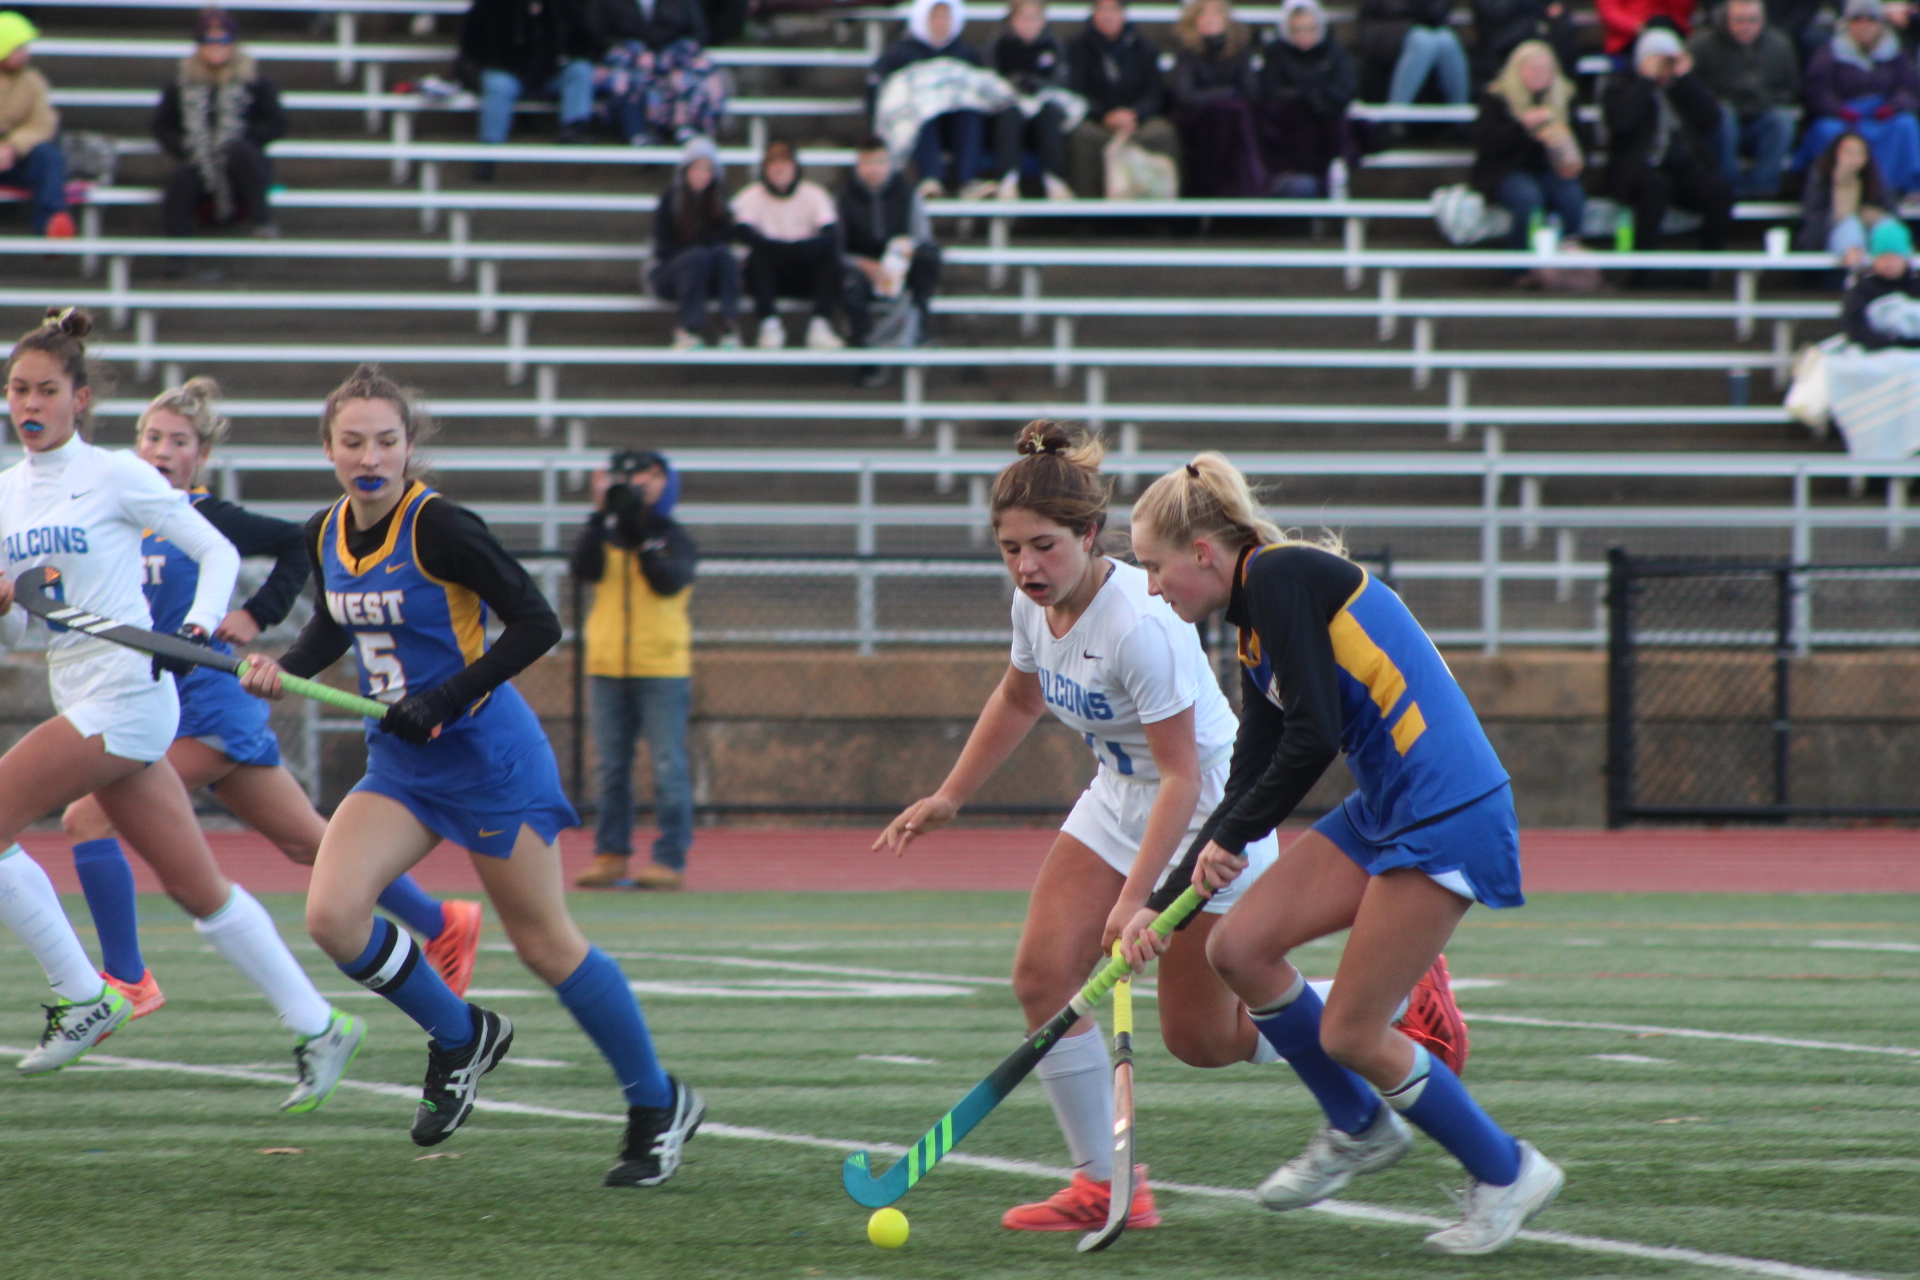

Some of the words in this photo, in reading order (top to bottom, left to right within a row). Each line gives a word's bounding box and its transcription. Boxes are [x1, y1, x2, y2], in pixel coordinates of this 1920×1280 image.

[325, 589, 405, 625] WEST
[354, 631, 407, 704] 5
[66, 1002, 111, 1041] OSAKA
